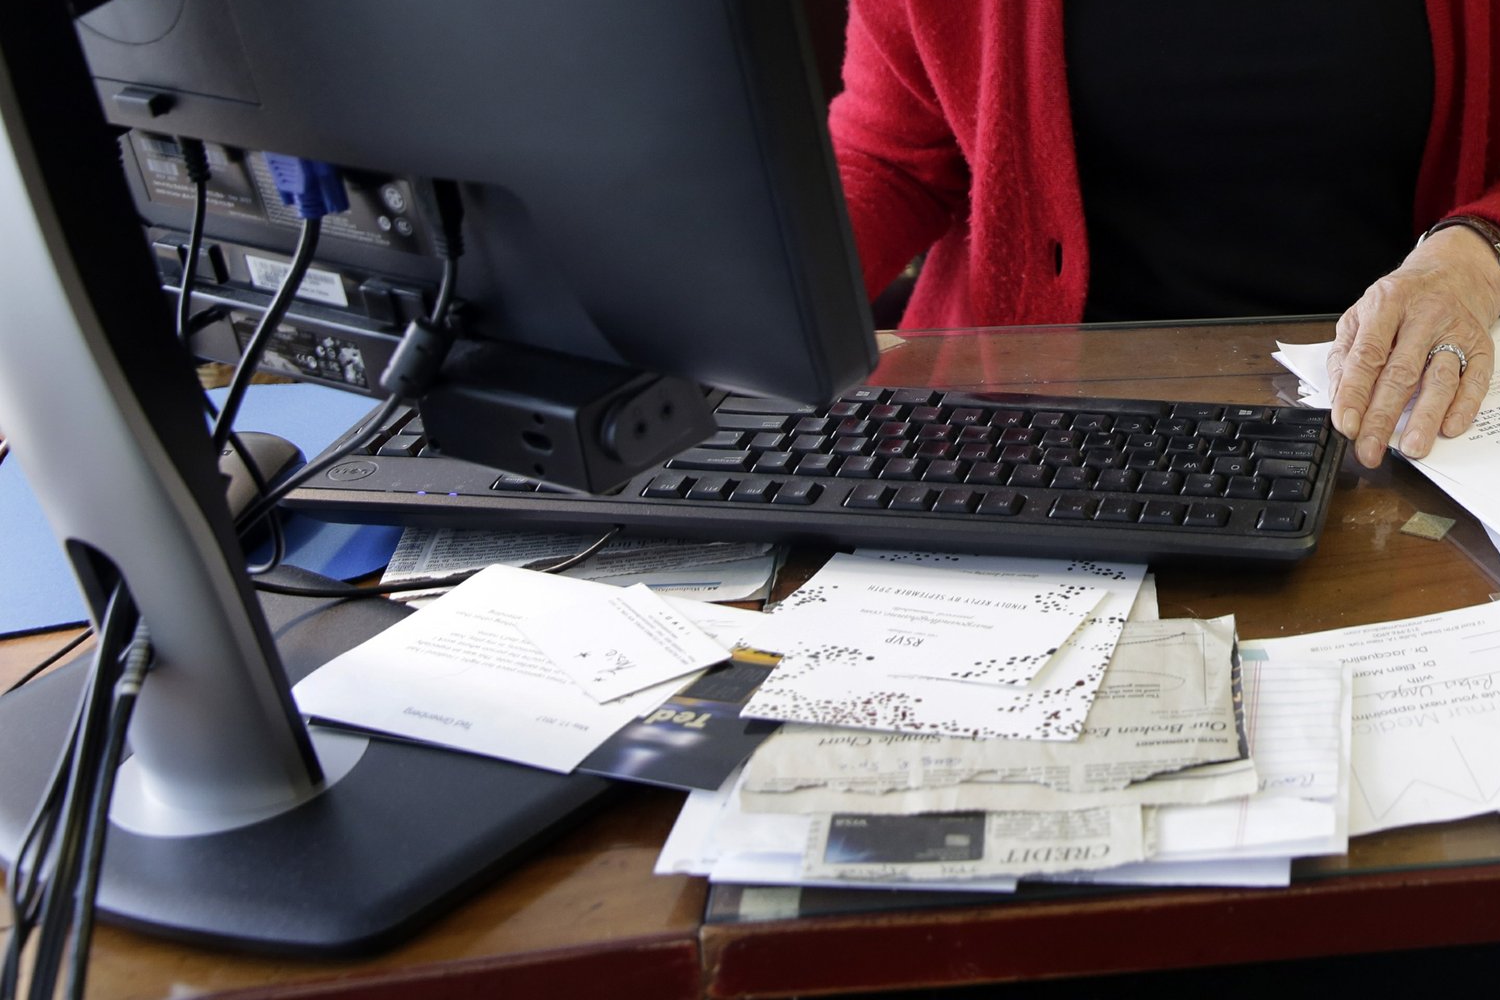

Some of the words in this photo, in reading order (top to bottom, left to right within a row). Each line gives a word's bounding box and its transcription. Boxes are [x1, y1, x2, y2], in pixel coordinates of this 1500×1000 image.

[866, 584, 893, 593] 29TH
[893, 588, 944, 600] SEPTEMBER
[964, 597, 992, 607] REPLY
[994, 601, 1027, 610] KINDLY
[884, 634, 924, 647] RSVP
[1414, 645, 1428, 653] Dr.
[1385, 663, 1416, 673] Ellen
[1422, 659, 1436, 667] Dr.
[1406, 673, 1433, 684] with
[1450, 692, 1477, 704] your
[1419, 699, 1447, 710] next
[402, 706, 454, 725] Greenberg
[643, 709, 712, 728] Ted
[453, 719, 472, 730] Ted
[1117, 723, 1183, 735] Broken
[1192, 720, 1227, 732] Our
[817, 733, 870, 747] Chart
[876, 730, 943, 745] Simple
[1000, 845, 1110, 864] CREDIT
